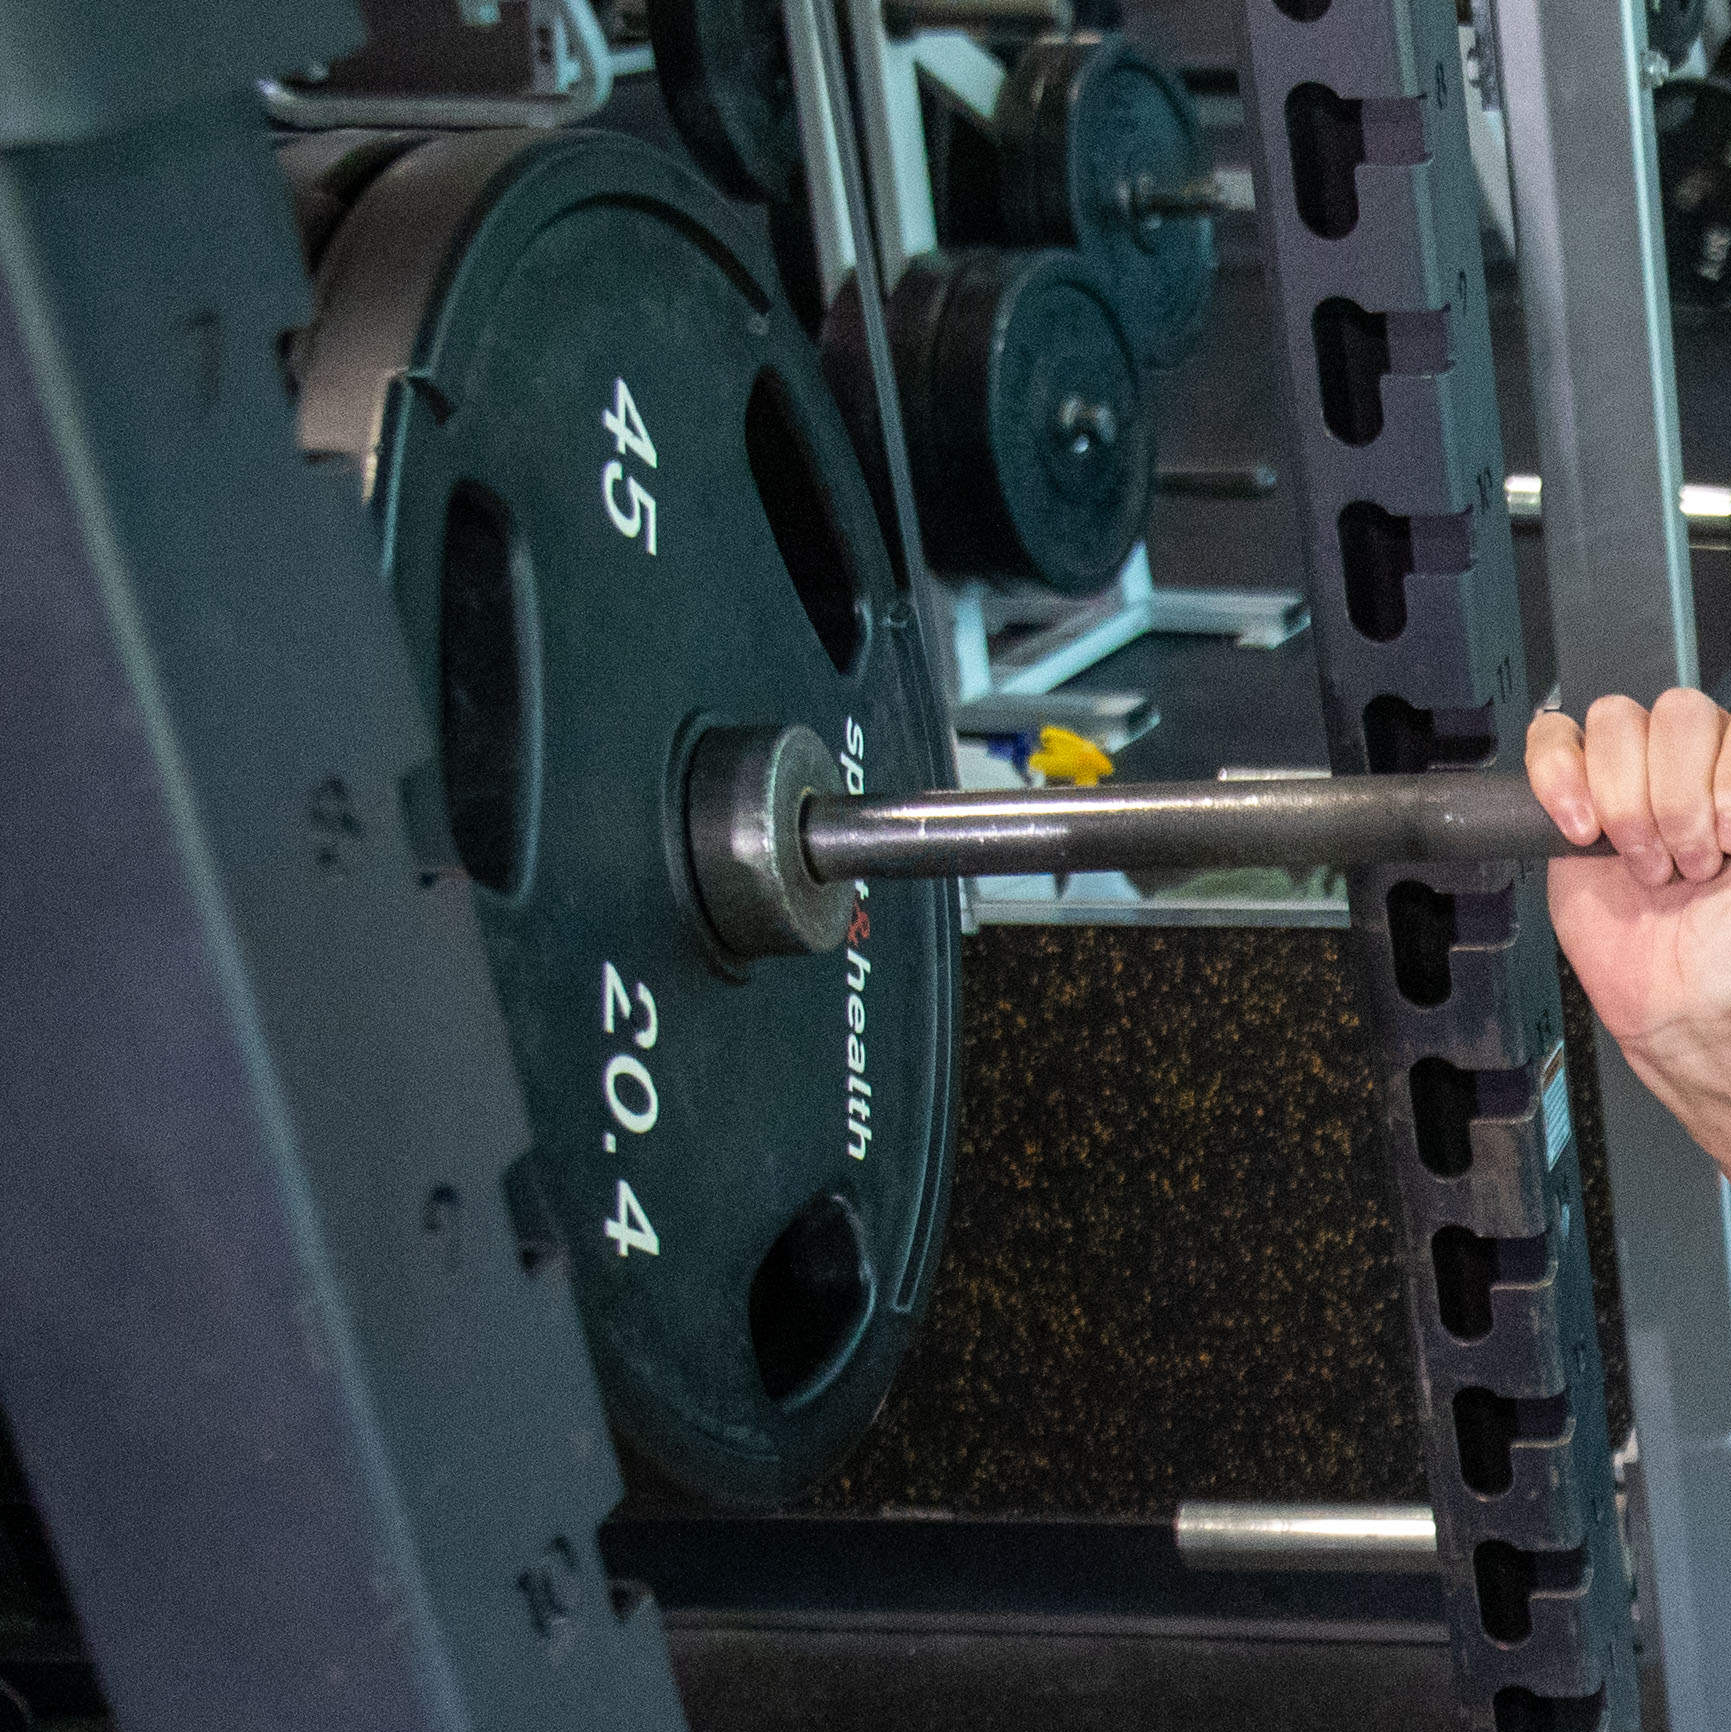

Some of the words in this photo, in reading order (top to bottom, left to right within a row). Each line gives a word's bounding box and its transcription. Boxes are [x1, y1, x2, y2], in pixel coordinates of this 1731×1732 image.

[599, 375, 659, 557] 45
[839, 715, 874, 1162] spt&health
[602, 960, 660, 1258] 20.4
